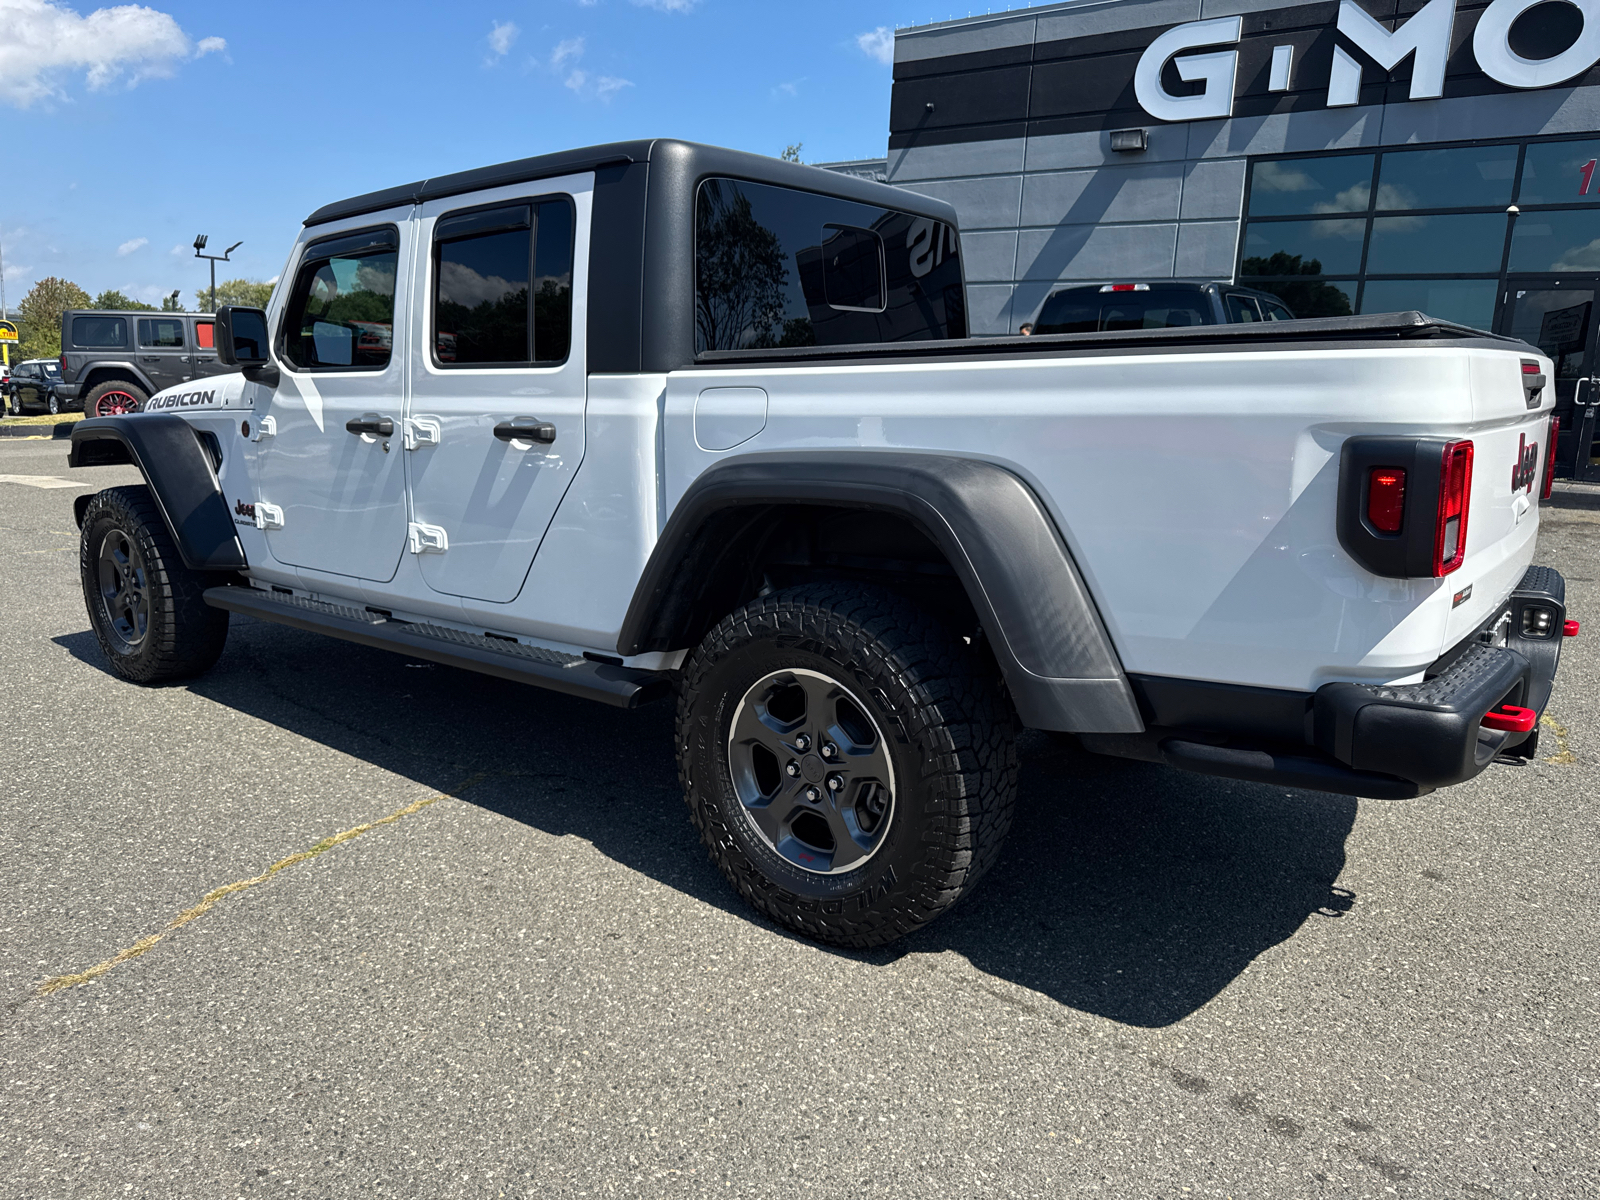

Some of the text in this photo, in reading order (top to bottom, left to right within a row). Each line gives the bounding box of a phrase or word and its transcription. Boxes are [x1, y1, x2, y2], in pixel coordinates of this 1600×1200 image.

[148, 390, 216, 411] RUBICON
[1511, 432, 1539, 495] Jeep
[234, 498, 257, 521] Jeep
[735, 858, 899, 916] WILDPEAK
